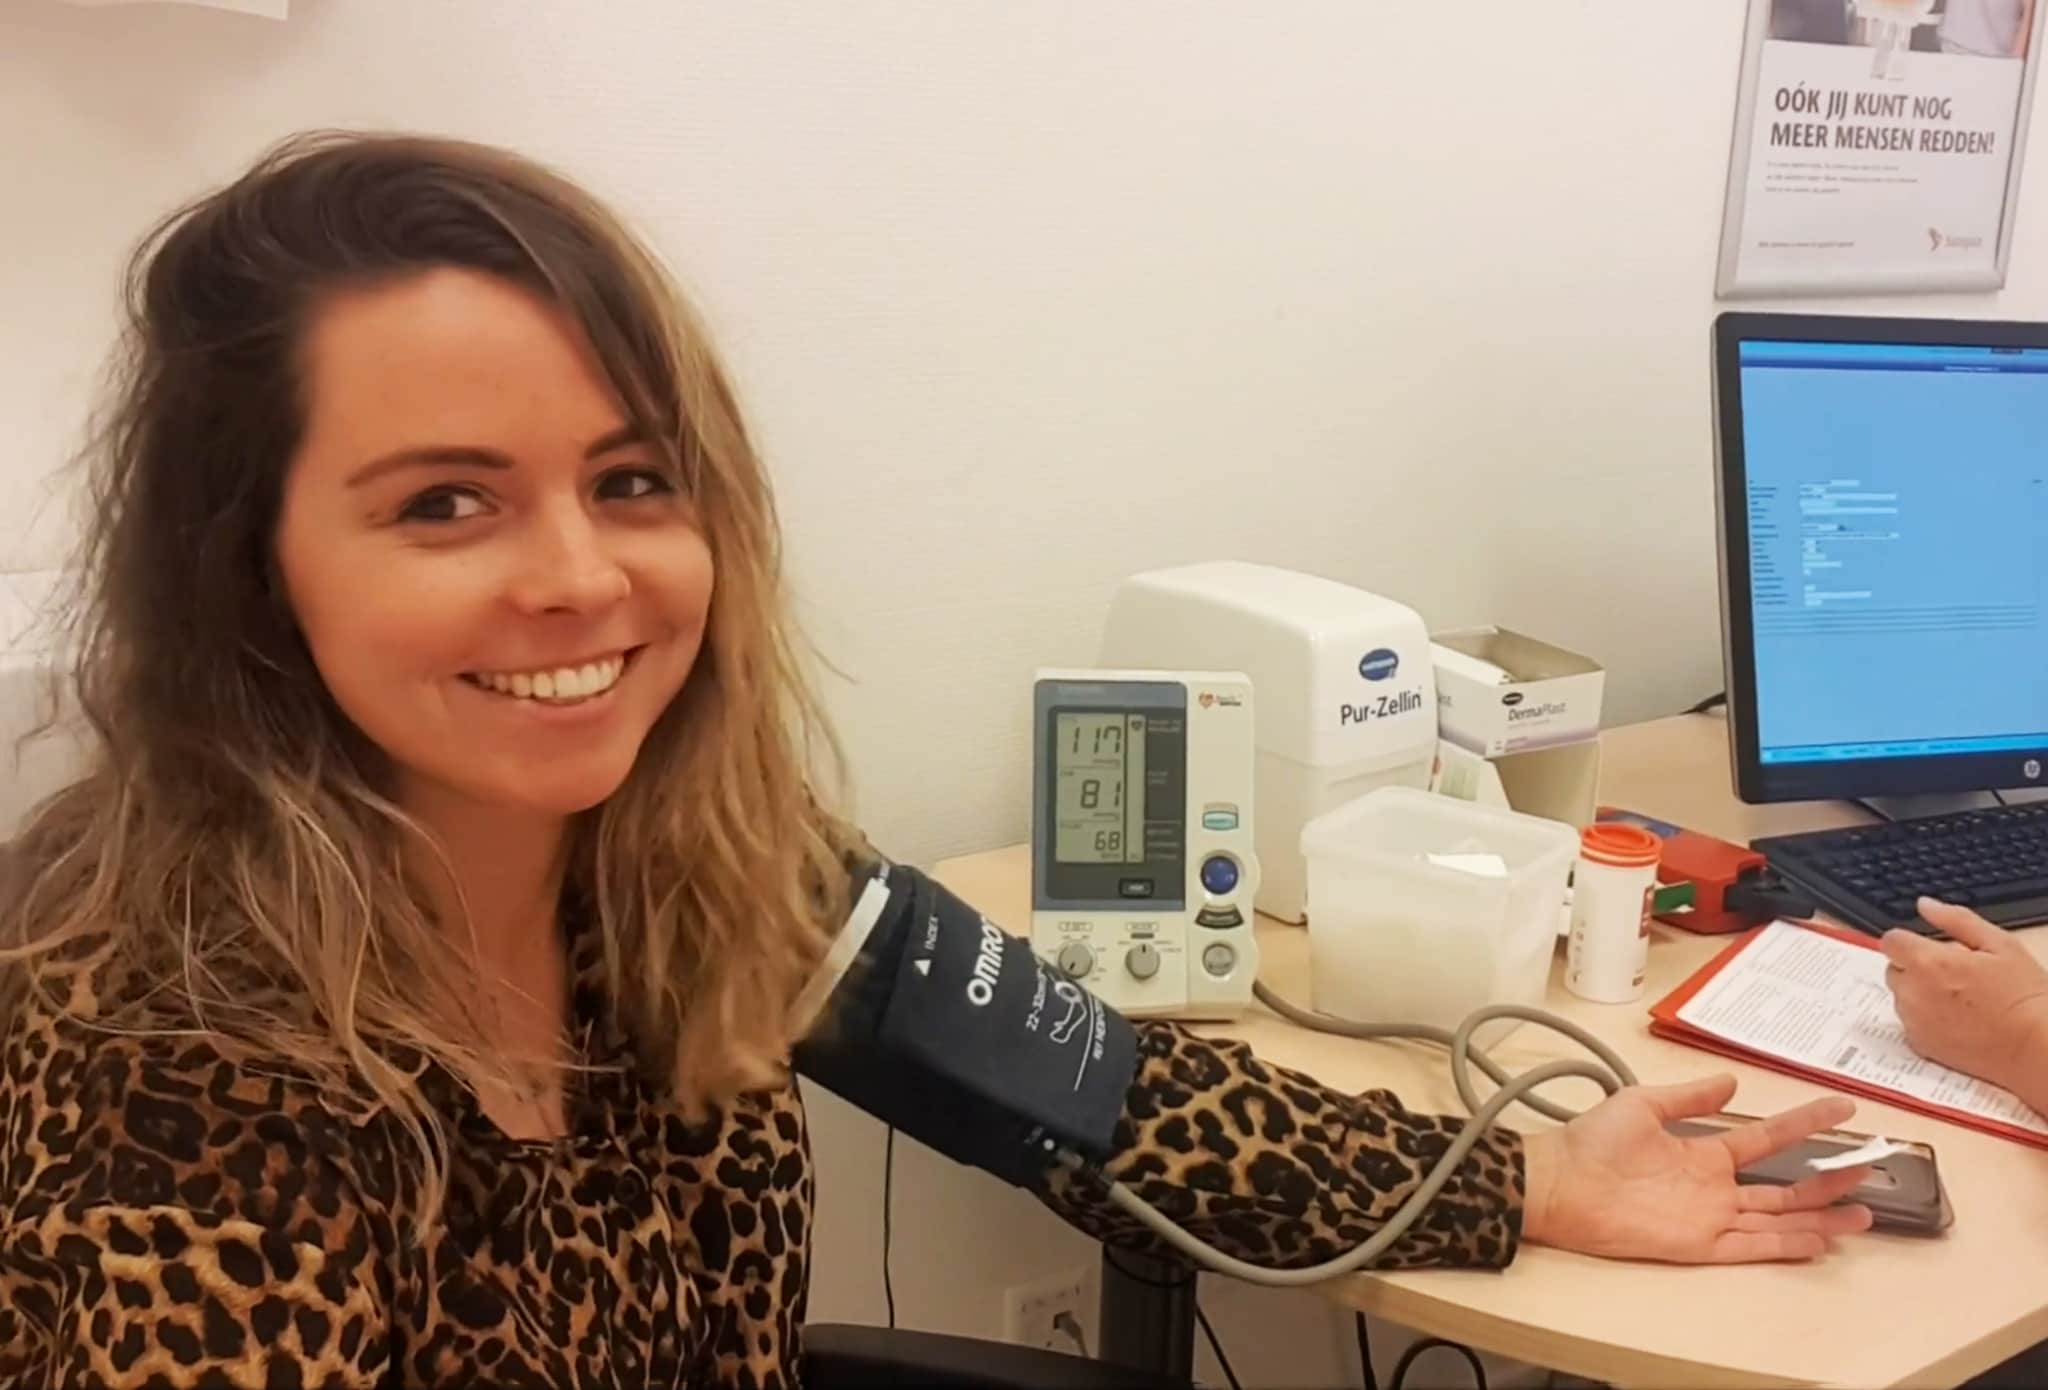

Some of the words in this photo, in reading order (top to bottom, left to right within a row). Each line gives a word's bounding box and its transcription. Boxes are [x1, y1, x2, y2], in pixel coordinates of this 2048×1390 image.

[1775, 80, 1821, 114] OÓK
[1826, 90, 1848, 120] JIJ
[1854, 92, 1908, 118] KUNT
[1912, 96, 1952, 120] NOG
[1770, 122, 1828, 148] MEER
[1835, 125, 1914, 152] MENSEN
[1919, 129, 1995, 155] REDDEN!
[1341, 690, 1421, 726] Pur-Zellin
[1508, 702, 1566, 721] DermaPlast
[1072, 725, 1122, 754] 117
[1080, 779, 1121, 809] 81
[1095, 830, 1121, 851] 68
[966, 914, 1004, 1006] OMRO
